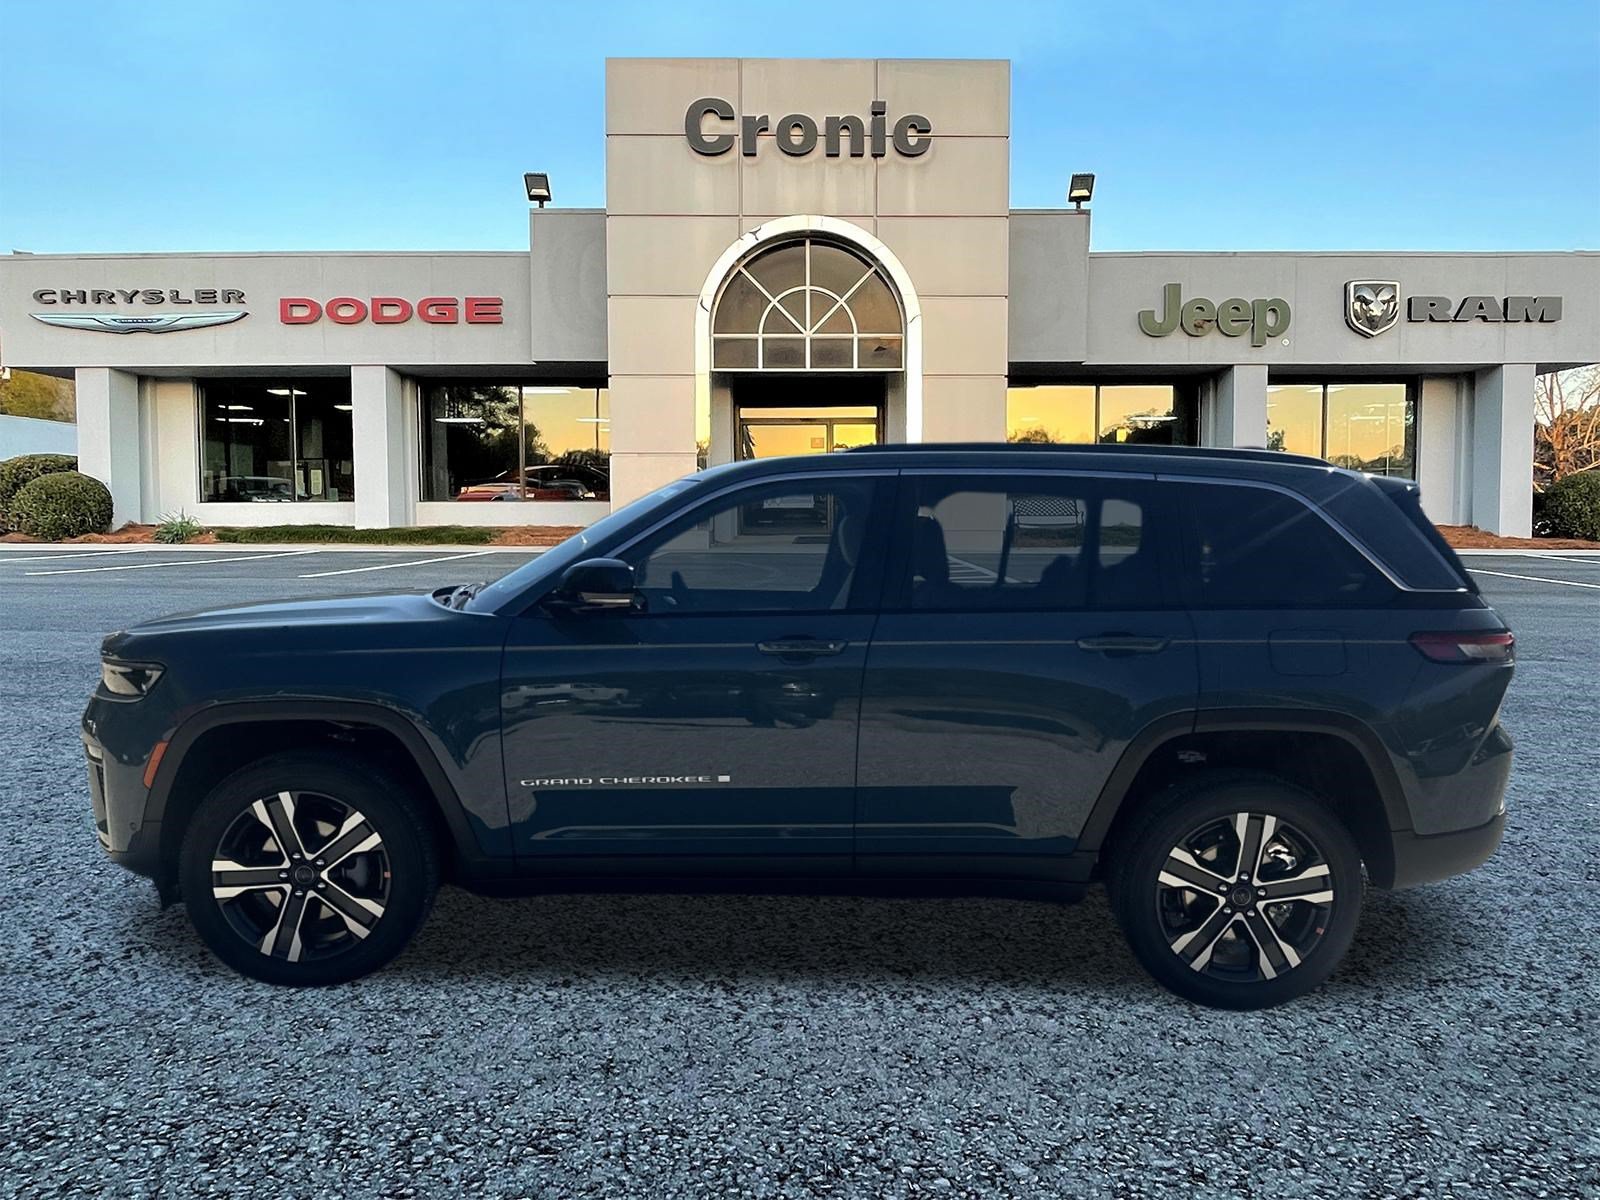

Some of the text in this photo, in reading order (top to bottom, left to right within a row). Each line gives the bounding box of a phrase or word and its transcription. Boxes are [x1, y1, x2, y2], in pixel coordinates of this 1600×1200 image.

[685, 97, 932, 158] Cronic
[32, 287, 246, 305] CHRYSLER
[1407, 296, 1563, 323] RAM
[279, 297, 504, 325] DODGE
[1138, 283, 1291, 347] Jeep
[520, 776, 713, 787] GRAND CHEROKEE
